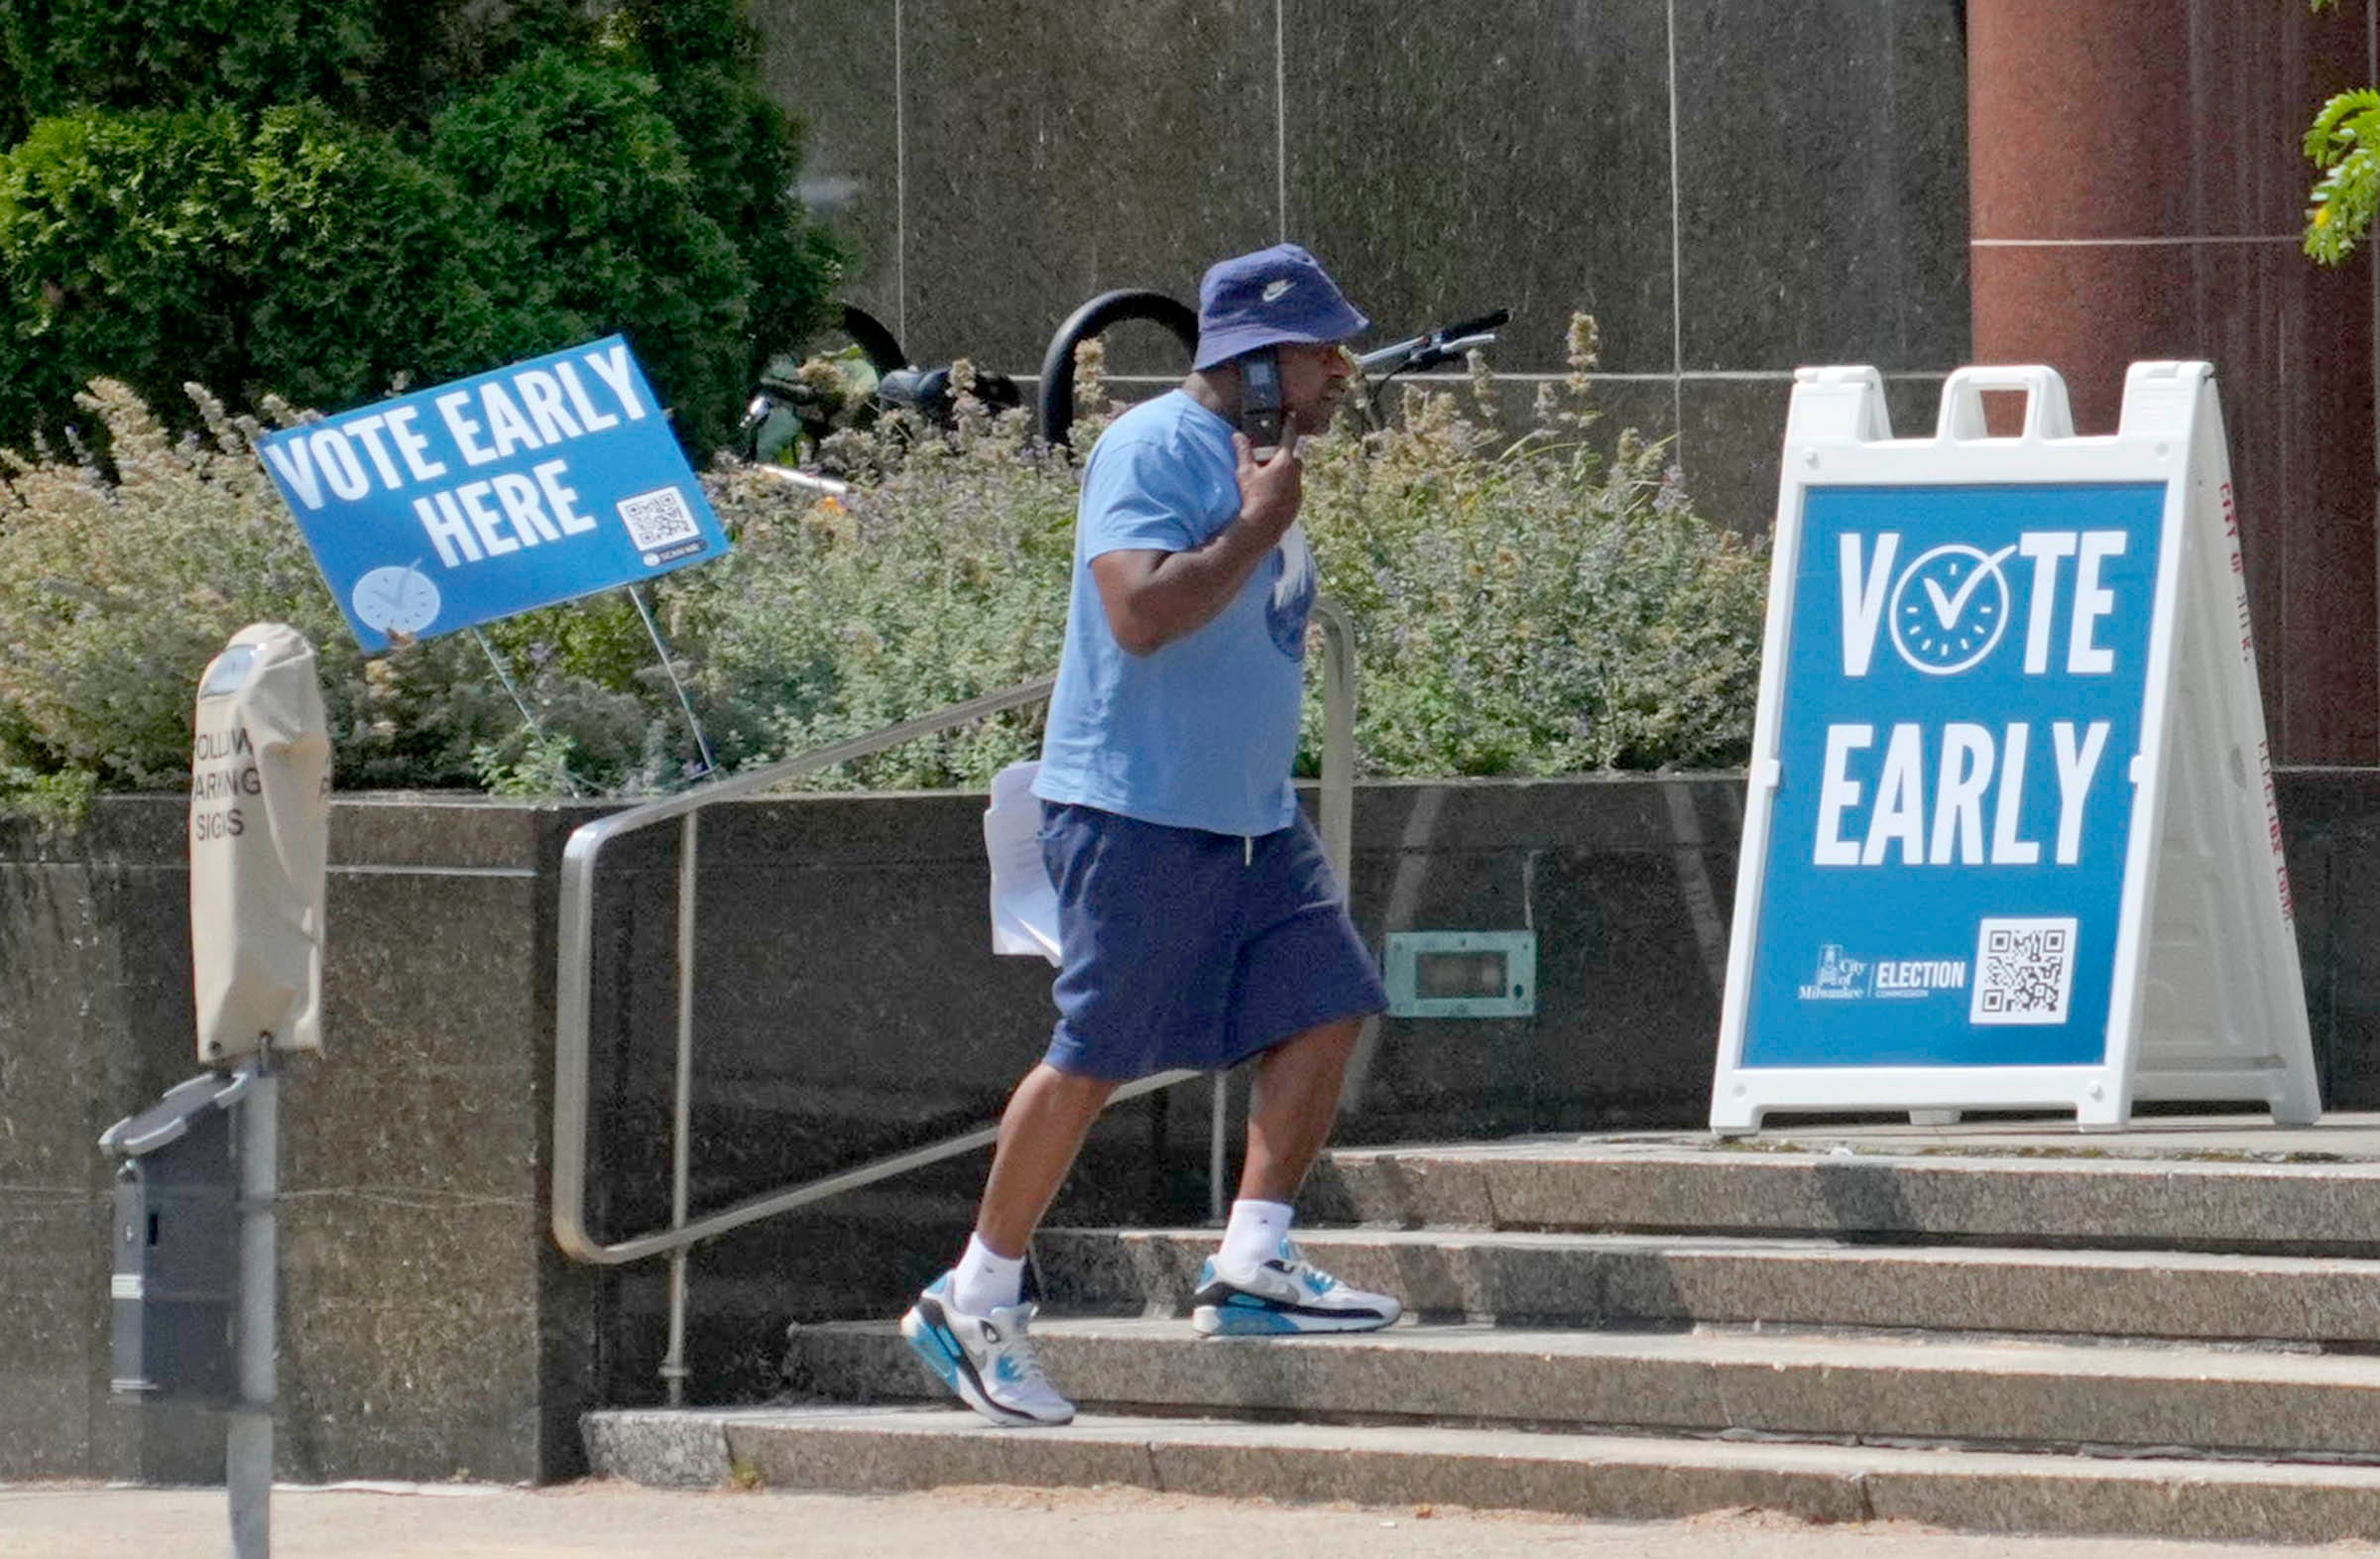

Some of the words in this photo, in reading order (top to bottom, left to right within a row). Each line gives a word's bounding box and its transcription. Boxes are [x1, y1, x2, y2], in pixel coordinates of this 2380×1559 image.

[264, 406, 447, 510] VOTE
[434, 345, 646, 465] EARLY
[413, 459, 595, 568] HERE
[1840, 532, 2127, 675] VOTE
[1814, 722, 2110, 865] EARLY
[1876, 961, 1964, 988] ELECTION
